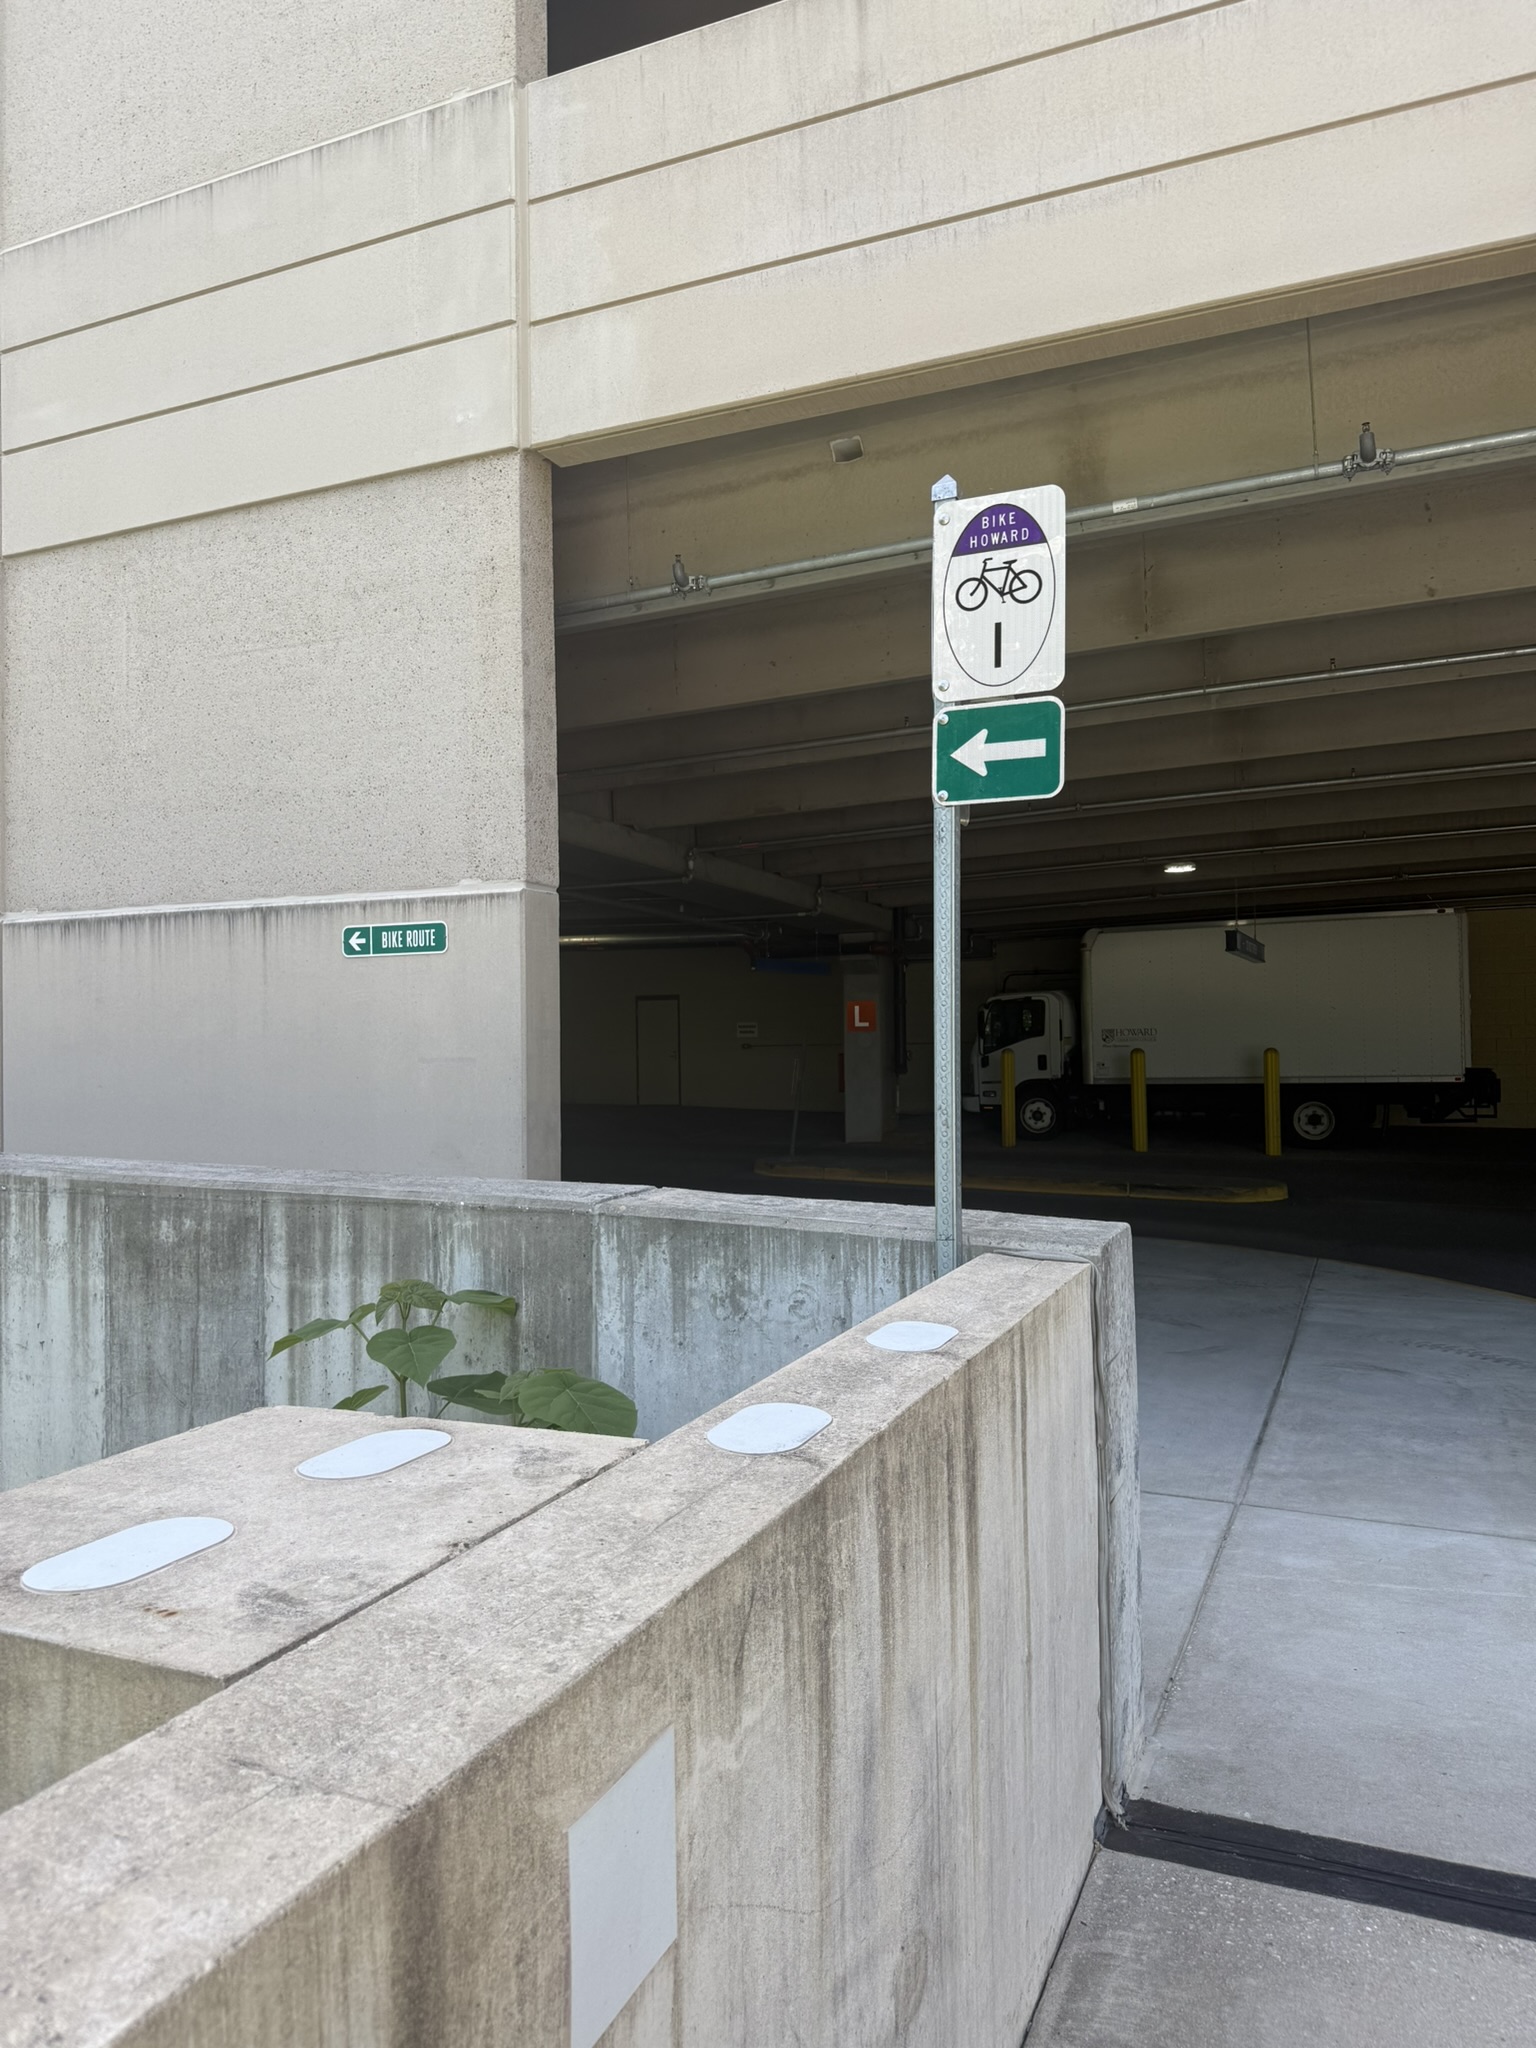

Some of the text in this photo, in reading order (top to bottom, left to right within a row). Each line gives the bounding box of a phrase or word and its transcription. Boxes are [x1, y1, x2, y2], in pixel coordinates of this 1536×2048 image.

[981, 512, 1016, 529] BIKE
[969, 528, 1029, 548] HOWARD
[381, 929, 436, 949] BIKE ROUTE
[854, 1005, 870, 1028] L
[1115, 1028, 1158, 1037] HOWARD
